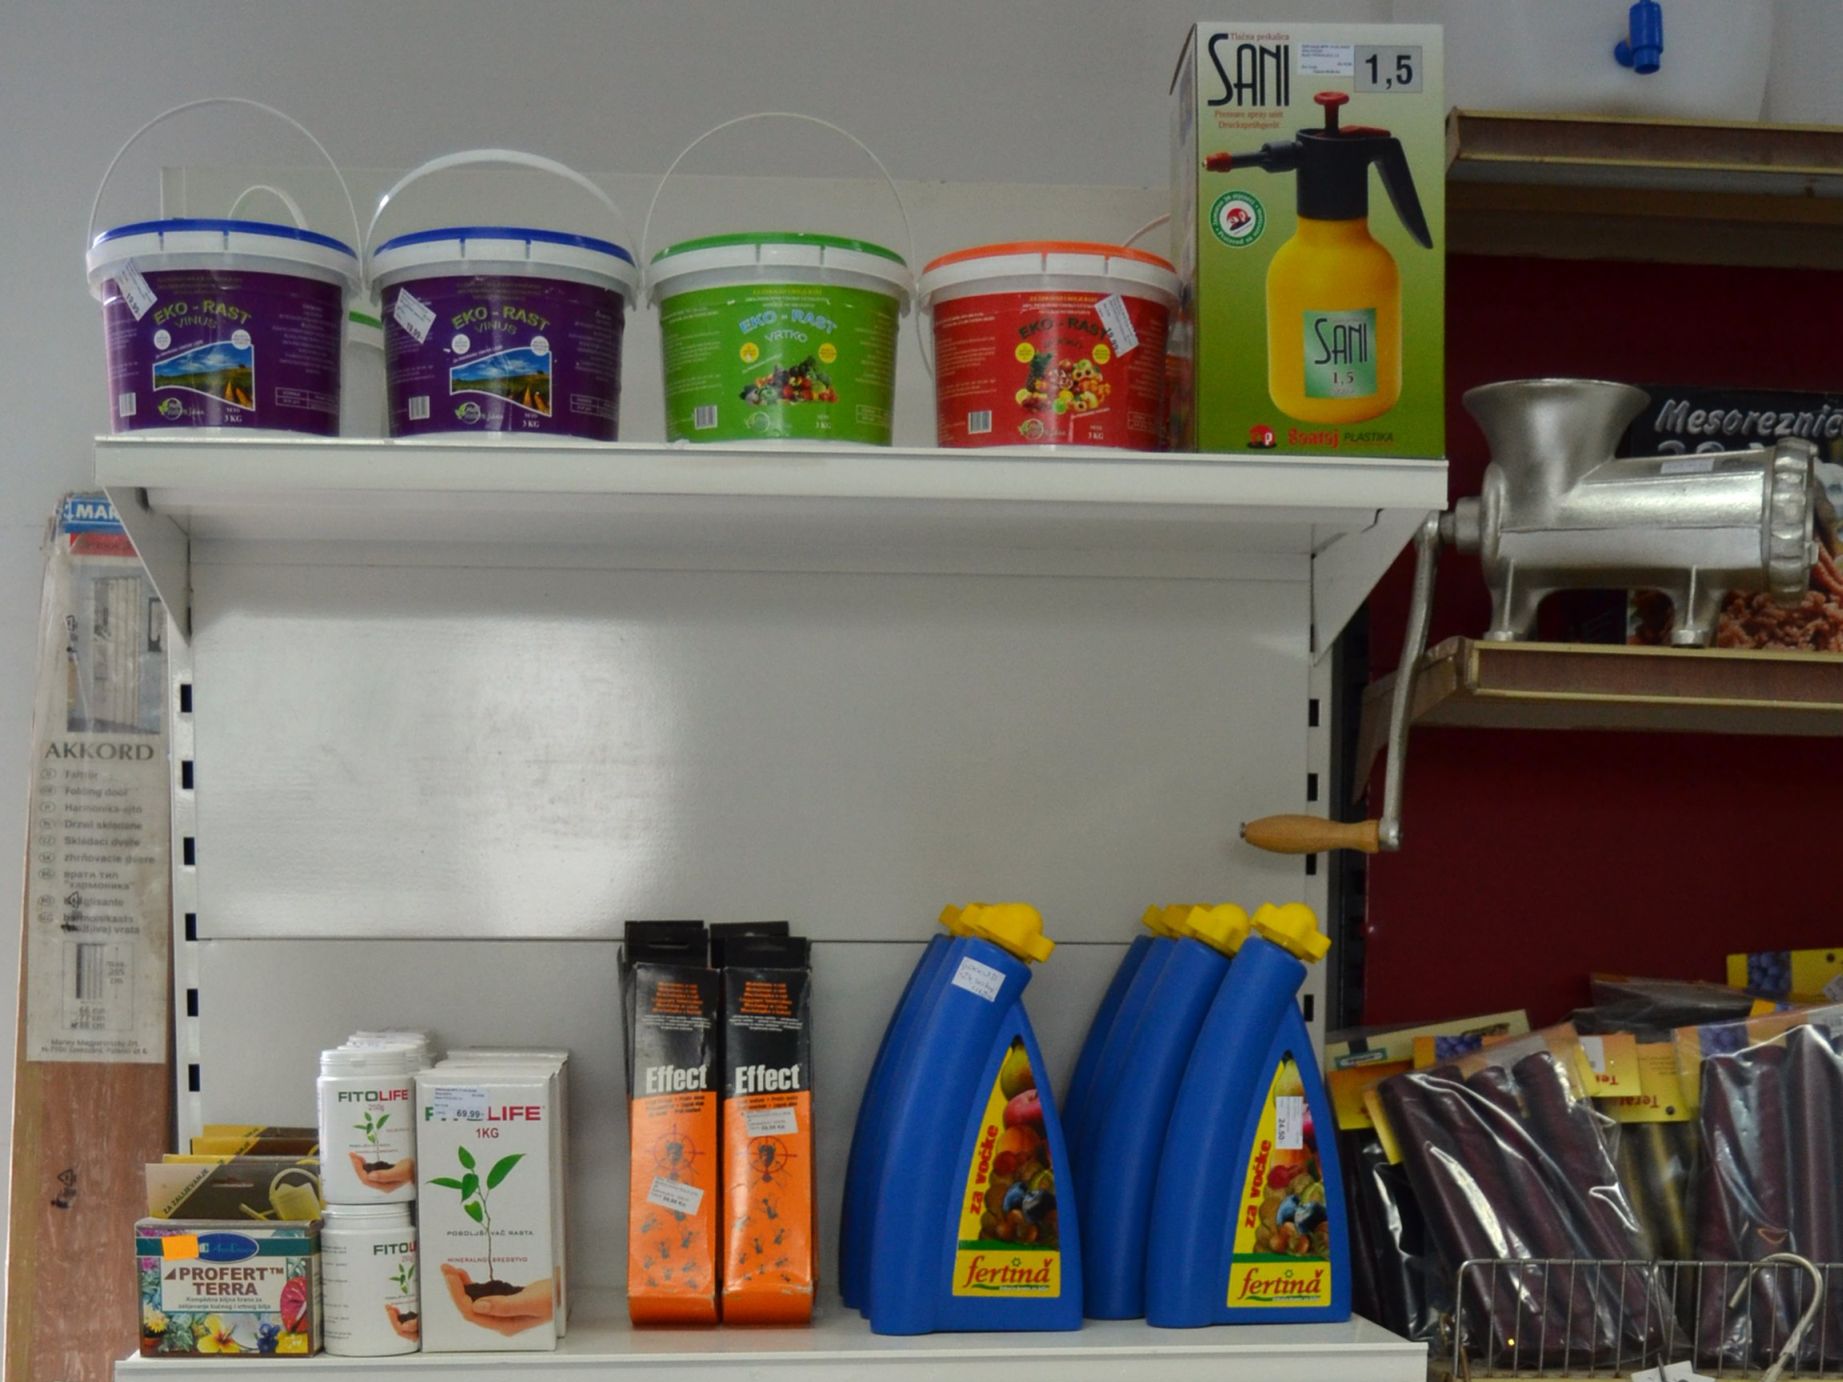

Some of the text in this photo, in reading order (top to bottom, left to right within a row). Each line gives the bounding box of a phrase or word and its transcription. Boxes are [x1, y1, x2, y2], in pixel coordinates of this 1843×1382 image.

[1207, 33, 1290, 107] SANI
[1364, 53, 1414, 90] 1,5
[153, 299, 252, 325] EKO RAST
[452, 305, 550, 331] EKO RAST
[738, 308, 838, 334] EKO RAST
[1019, 317, 1053, 339] EKO
[1314, 318, 1367, 365] SANI
[45, 742, 155, 761] AKKORD
[646, 1064, 708, 1094] Effect
[735, 1064, 800, 1094] Effect
[338, 1089, 409, 1103] FITOLIFE
[476, 1127, 499, 1139] 1KG
[970, 1191, 985, 1215] za
[1245, 1205, 1258, 1228] za
[193, 1283, 258, 1296] TERRA
